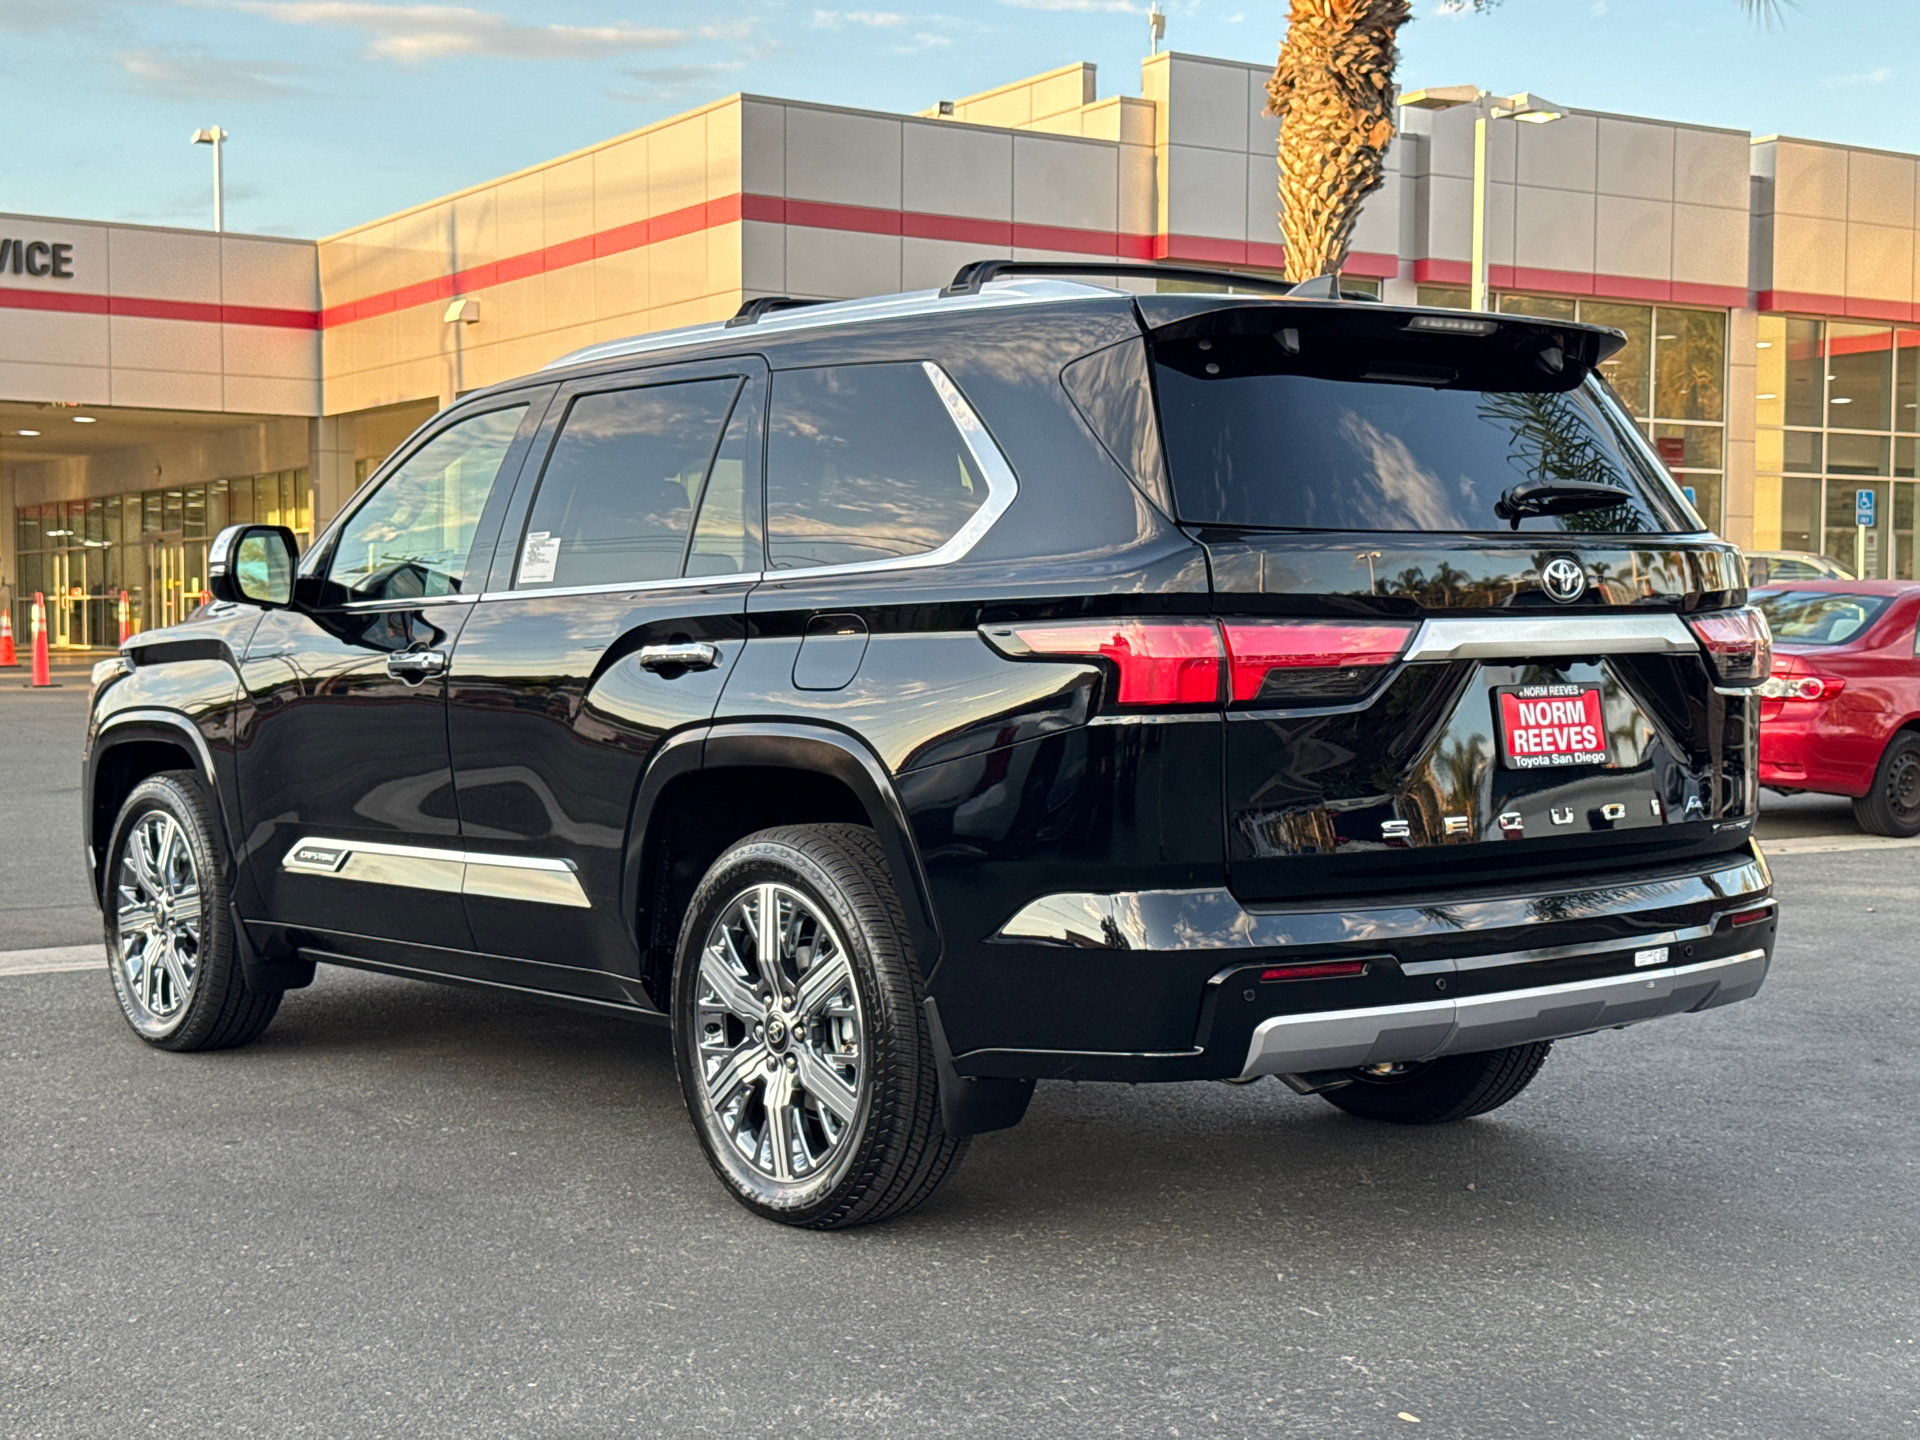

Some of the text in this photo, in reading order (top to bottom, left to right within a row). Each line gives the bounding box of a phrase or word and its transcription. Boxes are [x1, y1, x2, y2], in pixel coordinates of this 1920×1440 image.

[1523, 685, 1579, 697] NORM REEVES
[1518, 700, 1587, 727] NORM
[1513, 725, 1598, 753] REEVES
[1514, 752, 1606, 768] Toyota San Diego
[1381, 795, 1704, 839] SEQUOIA
